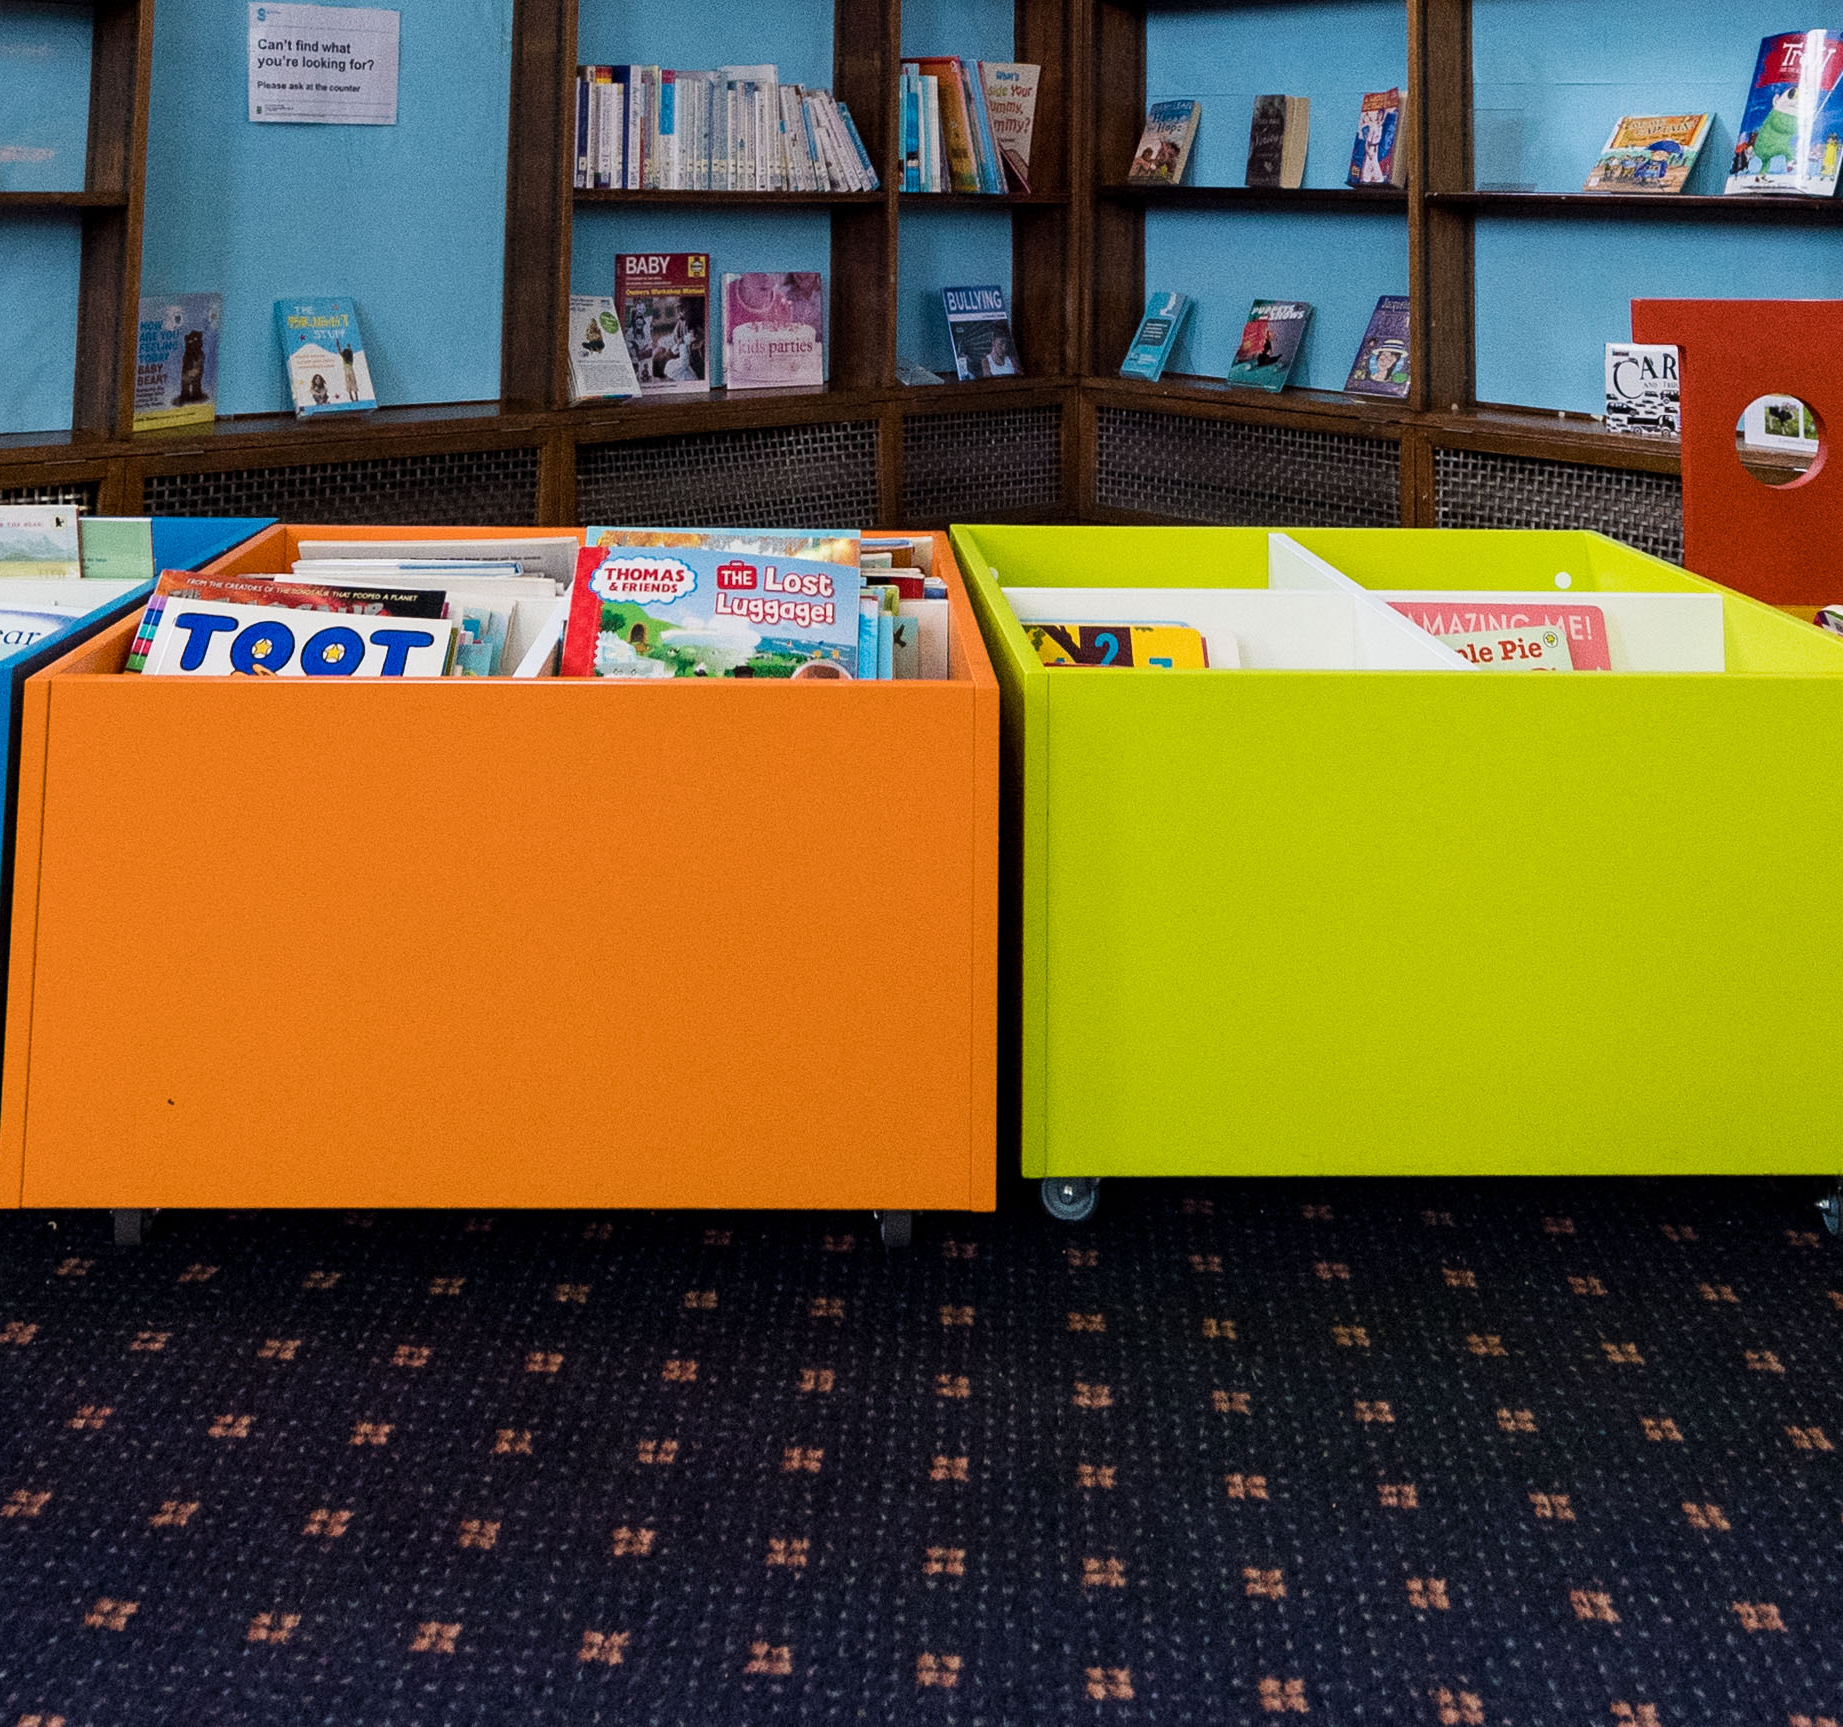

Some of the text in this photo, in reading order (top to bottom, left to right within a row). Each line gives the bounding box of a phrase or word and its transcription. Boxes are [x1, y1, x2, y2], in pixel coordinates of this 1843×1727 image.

[258, 39, 351, 54] Can't find what
[258, 56, 375, 72] you're looking for?
[257, 81, 287, 90] Please
[288, 82, 303, 90] ask
[315, 83, 327, 91] the
[989, 85, 1007, 97] side
[990, 101, 1023, 115] ummy,
[994, 116, 1030, 133] mmy?
[625, 256, 670, 274] BABY
[947, 290, 1002, 311] BULLYING
[294, 306, 313, 314] THE
[1251, 304, 1295, 315] PUPPETS
[1268, 310, 1305, 320] SHOWS
[738, 337, 813, 357] kids parties
[605, 567, 685, 582] THOMAS
[721, 567, 834, 596] THE Lost
[187, 578, 207, 587] FROM
[209, 580, 224, 588] THE
[224, 582, 263, 593] CREATORS
[264, 585, 274, 593] OF
[276, 586, 290, 594] THE
[291, 587, 330, 597] DINOSAUR
[332, 590, 350, 598] THAT
[352, 591, 381, 600] POOPED
[390, 593, 418, 602] PLANET
[608, 582, 678, 593] & FRIENDS
[716, 592, 835, 628] Luggage!
[1407, 612, 1592, 640] AMAZING ME!
[175, 612, 434, 676] TOOT
[1455, 638, 1543, 663] ple Pie
